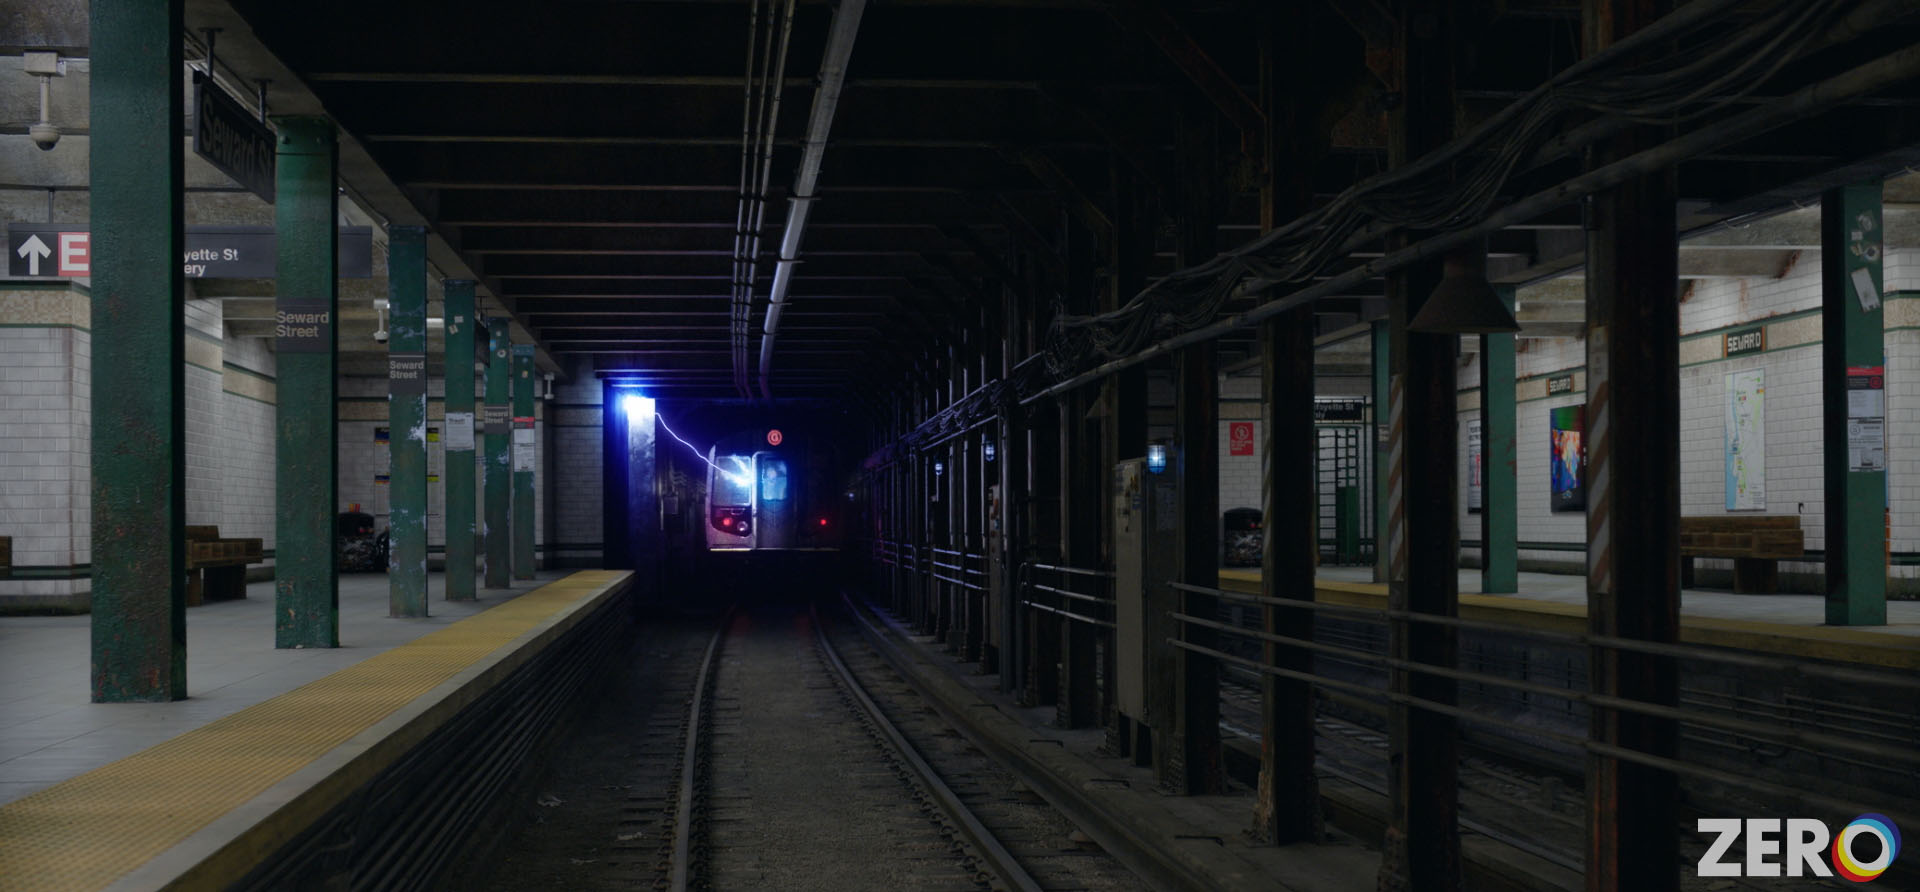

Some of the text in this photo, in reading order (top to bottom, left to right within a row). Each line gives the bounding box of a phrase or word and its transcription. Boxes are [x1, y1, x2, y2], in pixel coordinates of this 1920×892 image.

[201, 92, 256, 180] Seward
[223, 248, 239, 262] St
[184, 264, 206, 277] ery
[276, 311, 329, 324] Seward
[276, 324, 320, 338] Street
[1727, 331, 1762, 353] SEWARD
[390, 360, 425, 370] Seward
[390, 370, 418, 379] Street
[1549, 377, 1571, 393] SEWARD
